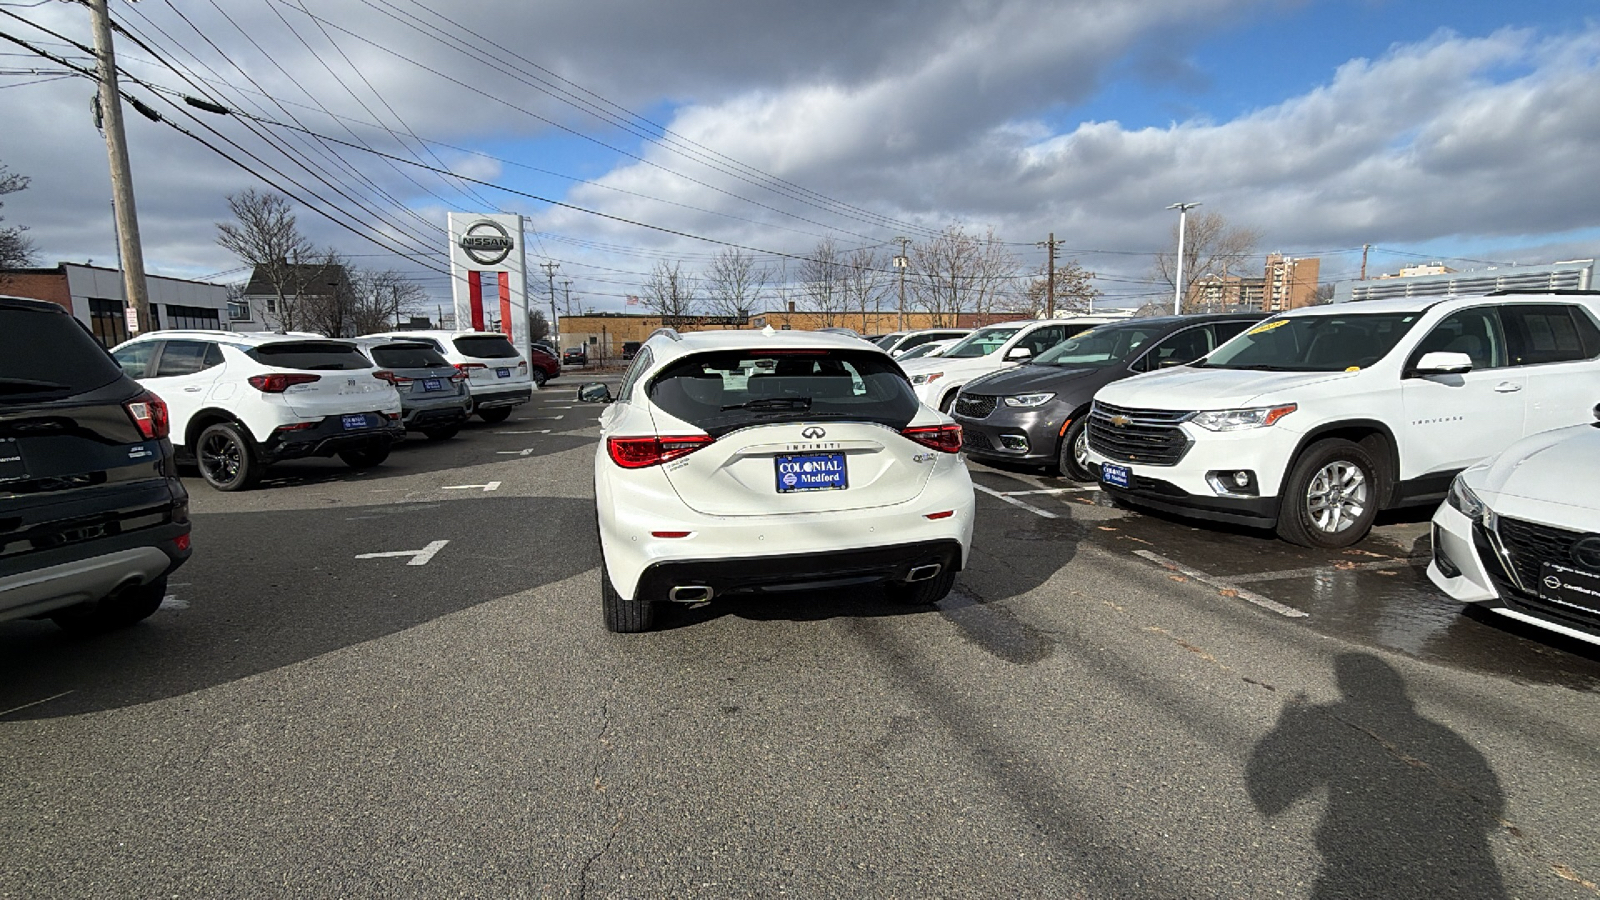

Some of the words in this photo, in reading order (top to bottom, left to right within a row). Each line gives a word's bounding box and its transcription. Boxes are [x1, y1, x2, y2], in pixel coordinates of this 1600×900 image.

[463, 238, 508, 246] NISSAN
[786, 443, 840, 451] INFINITI
[780, 460, 842, 473] COLONIAL
[801, 473, 840, 483] Medford
